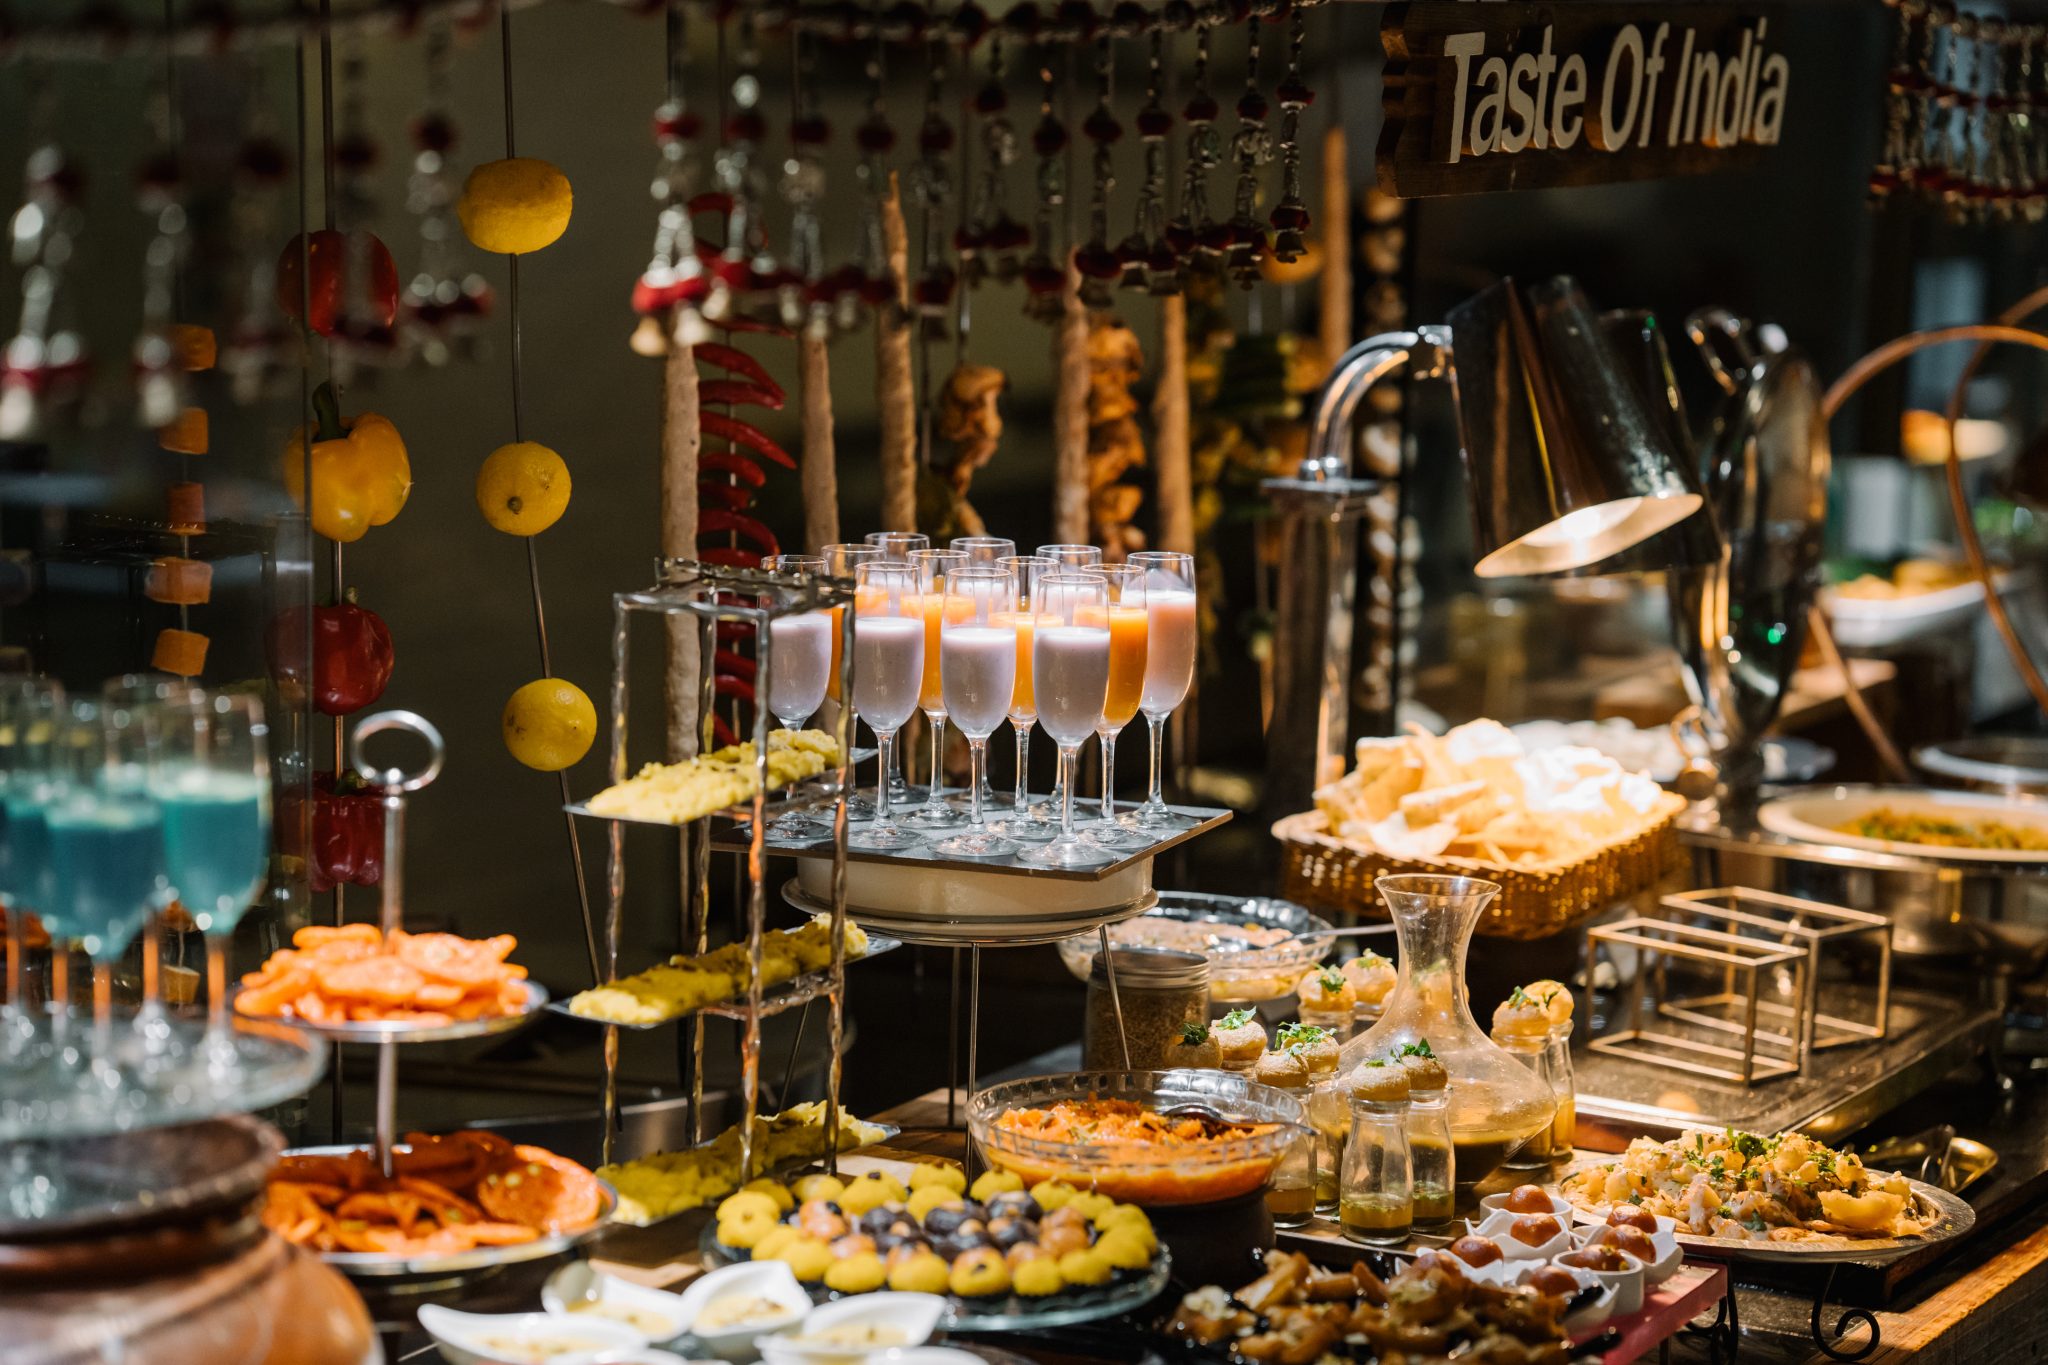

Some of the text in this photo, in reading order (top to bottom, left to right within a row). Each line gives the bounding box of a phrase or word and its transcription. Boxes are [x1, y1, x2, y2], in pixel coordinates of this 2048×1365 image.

[1444, 17, 1789, 163] Taste Of India
